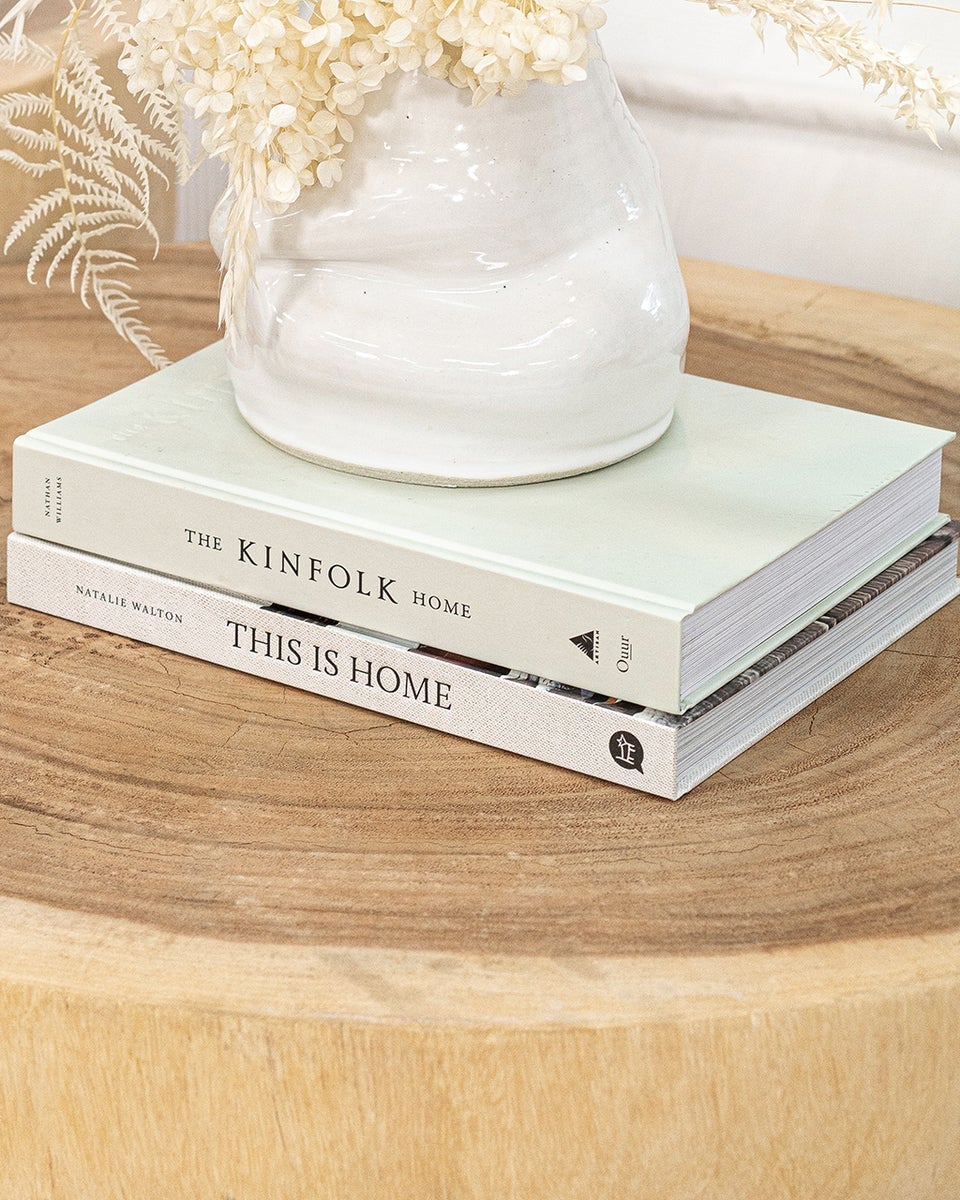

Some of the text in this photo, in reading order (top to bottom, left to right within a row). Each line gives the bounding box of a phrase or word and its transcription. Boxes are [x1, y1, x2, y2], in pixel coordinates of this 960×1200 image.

[75, 584, 183, 624] NATALIE WALTON
[184, 528, 472, 619] THE KINFOLK HOME
[226, 620, 452, 711] THIS IS HOME
[616, 634, 631, 673] Ouur
